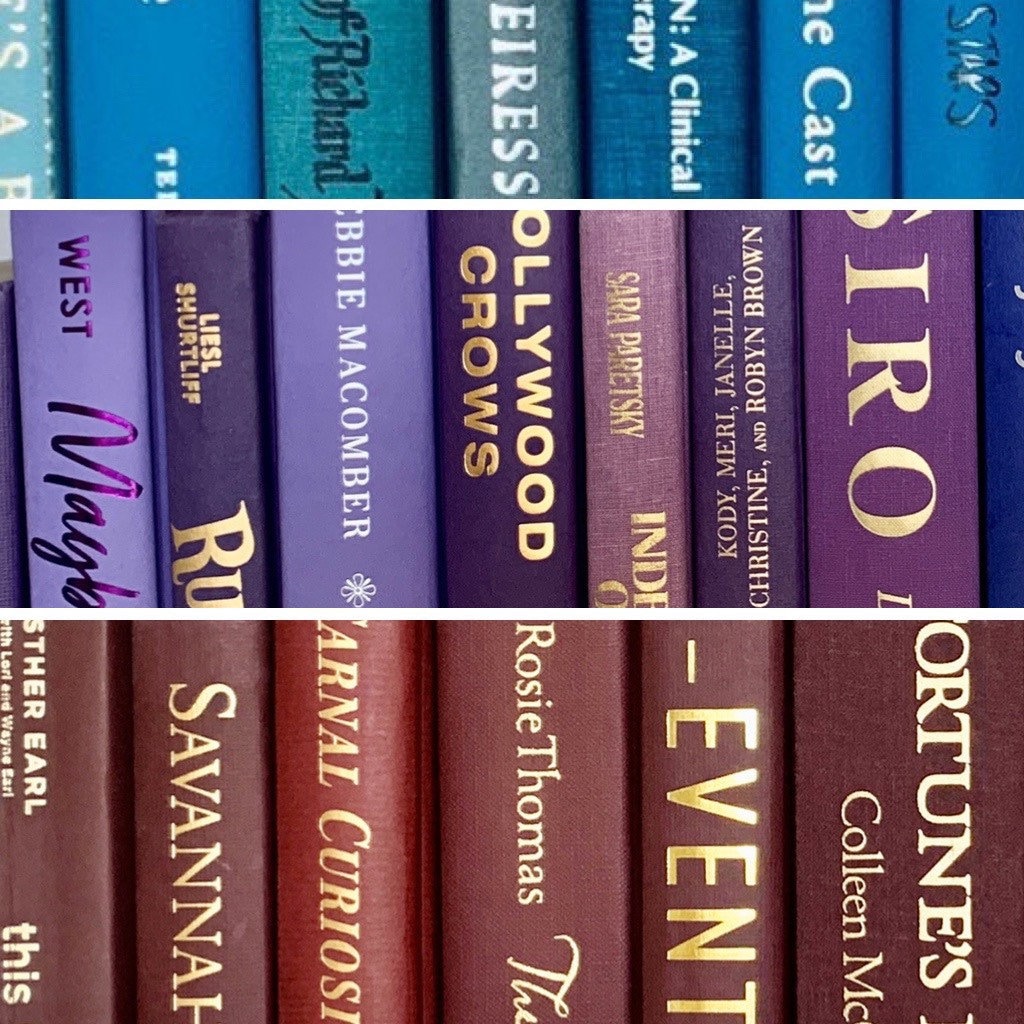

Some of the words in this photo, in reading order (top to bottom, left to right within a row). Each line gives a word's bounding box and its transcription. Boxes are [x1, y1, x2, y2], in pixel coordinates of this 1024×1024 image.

[300, 26, 375, 196] Richard
[669, 42, 700, 67] A
[945, 2, 1002, 129] STARS
[669, 73, 702, 194] Clinical
[801, 66, 853, 187] Cast
[58, 234, 94, 338] WEST
[605, 271, 641, 325] SARA
[741, 224, 764, 322] BROWN
[175, 282, 202, 405] SHURTLIFF
[199, 312, 223, 374] LIESL
[460, 245, 500, 478] CROWS
[511, 210, 556, 561] OLLYWOOD
[607, 330, 646, 440] PARETSKY
[711, 274, 738, 398] JANELLE,
[743, 326, 766, 415] ROBYN
[338, 324, 372, 541] MACOMBER
[714, 405, 738, 473] MERI,
[754, 420, 767, 452] AND
[716, 476, 739, 560] KODY,
[749, 458, 772, 607] CHRISTINE,
[515, 622, 556, 734] Rosie
[22, 731, 48, 817] EARL
[515, 735, 563, 906] Thomas
[914, 621, 973, 990] ORTUNE’S
[318, 808, 372, 1024] CURIOSI
[666, 707, 759, 1024] EVENT
[841, 789, 884, 942] Colleen
[2, 921, 41, 1006] this
[842, 951, 884, 1024] Mc
